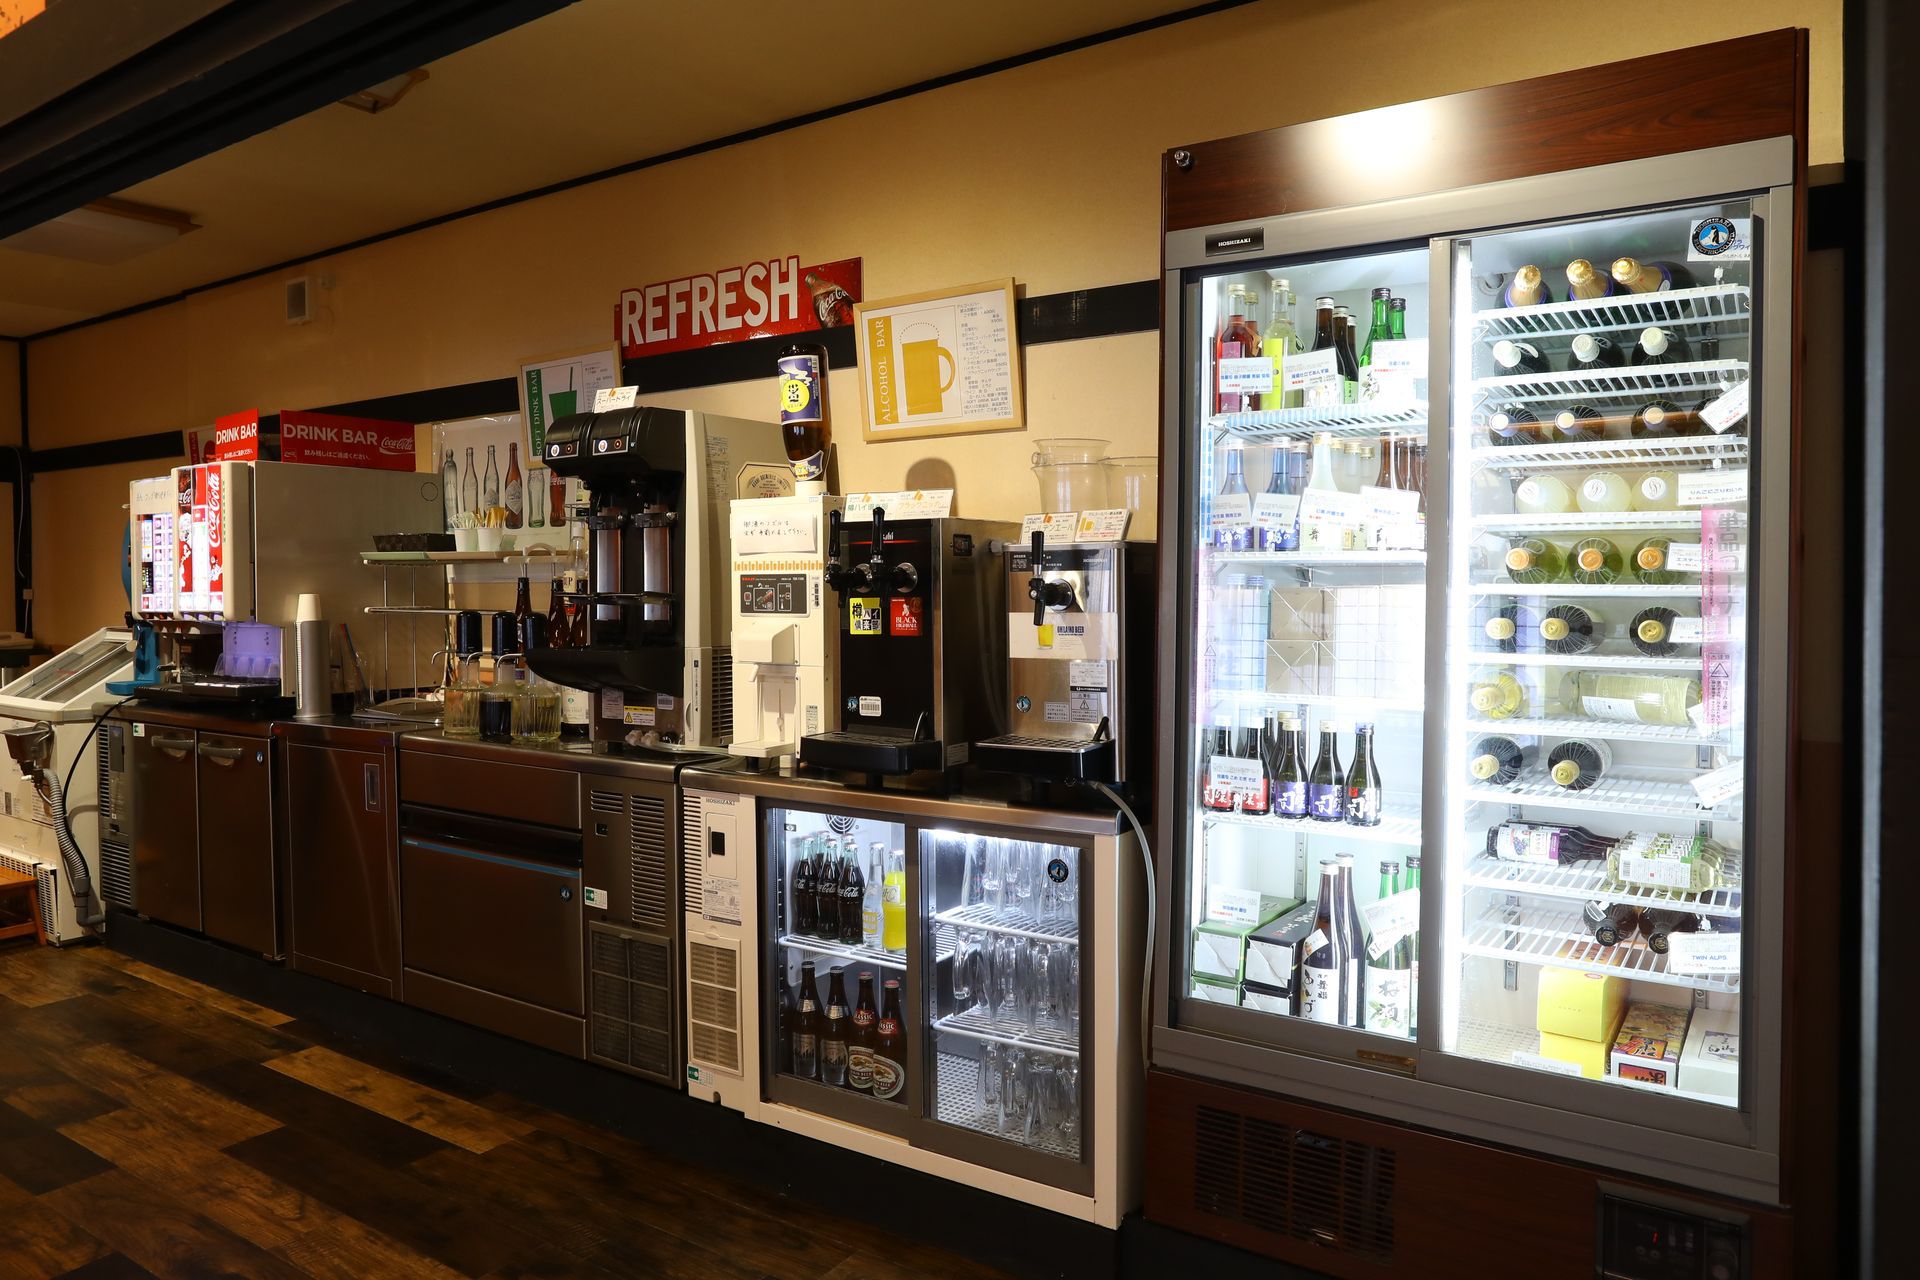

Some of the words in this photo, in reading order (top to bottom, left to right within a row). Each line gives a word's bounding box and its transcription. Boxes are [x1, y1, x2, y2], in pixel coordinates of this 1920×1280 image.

[1218, 237, 1251, 247] HOSHIZAKI
[622, 257, 799, 347] REFRESH
[875, 319, 886, 348] BAR
[531, 371, 539, 393] BAR
[878, 356, 892, 422] ALCOHOL
[216, 425, 239, 445] DRINK
[239, 422, 257, 440] BAR
[283, 423, 338, 442] DRINK
[342, 428, 378, 445] BAR
[534, 427, 543, 456] SOFT
[379, 436, 415, 454] Coca-Cola
[208, 472, 221, 548] Coca-Cola
[852, 602, 880, 619] 樽ハイ
[895, 616, 918, 624] BLACK
[854, 619, 880, 630] 倶楽部
[1075, 625, 1084, 633] BEER
